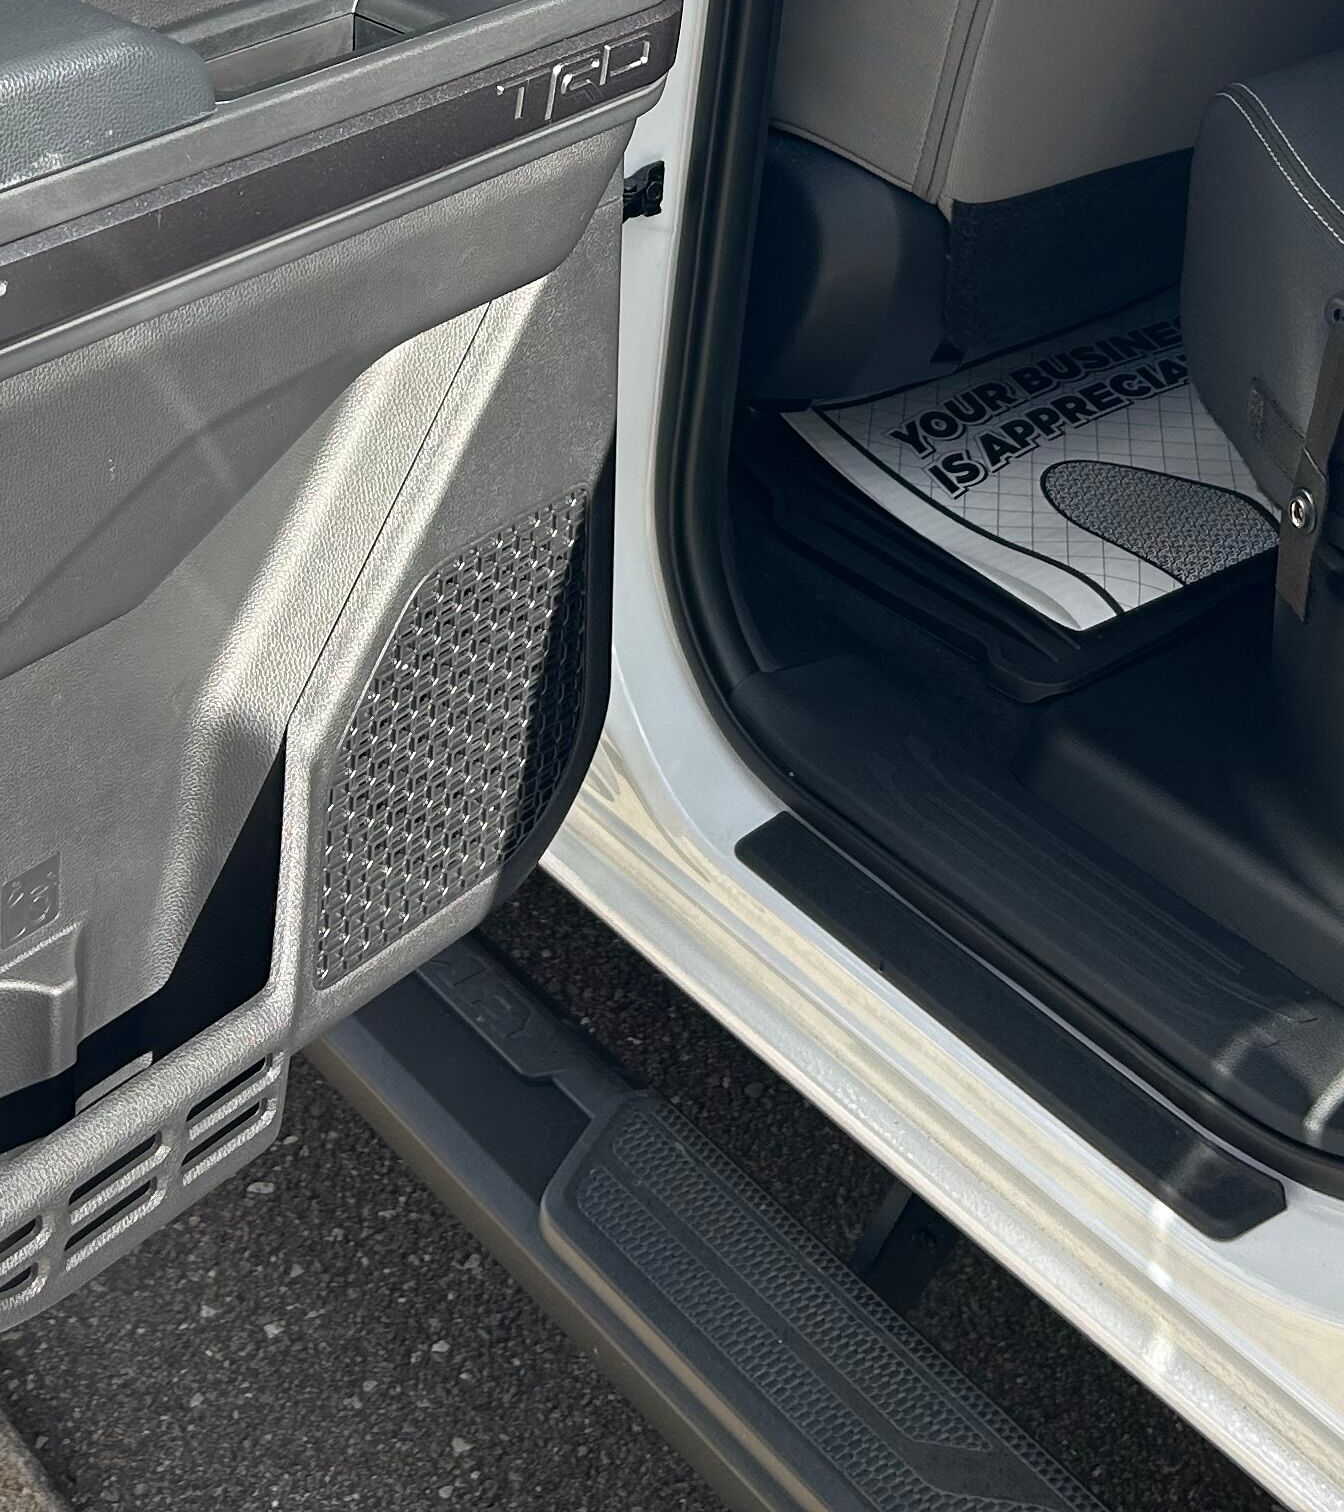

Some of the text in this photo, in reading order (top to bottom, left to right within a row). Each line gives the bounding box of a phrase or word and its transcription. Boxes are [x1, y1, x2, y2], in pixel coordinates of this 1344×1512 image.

[887, 316, 1182, 458] YOUR BUSINE
[924, 448, 988, 498] IS
